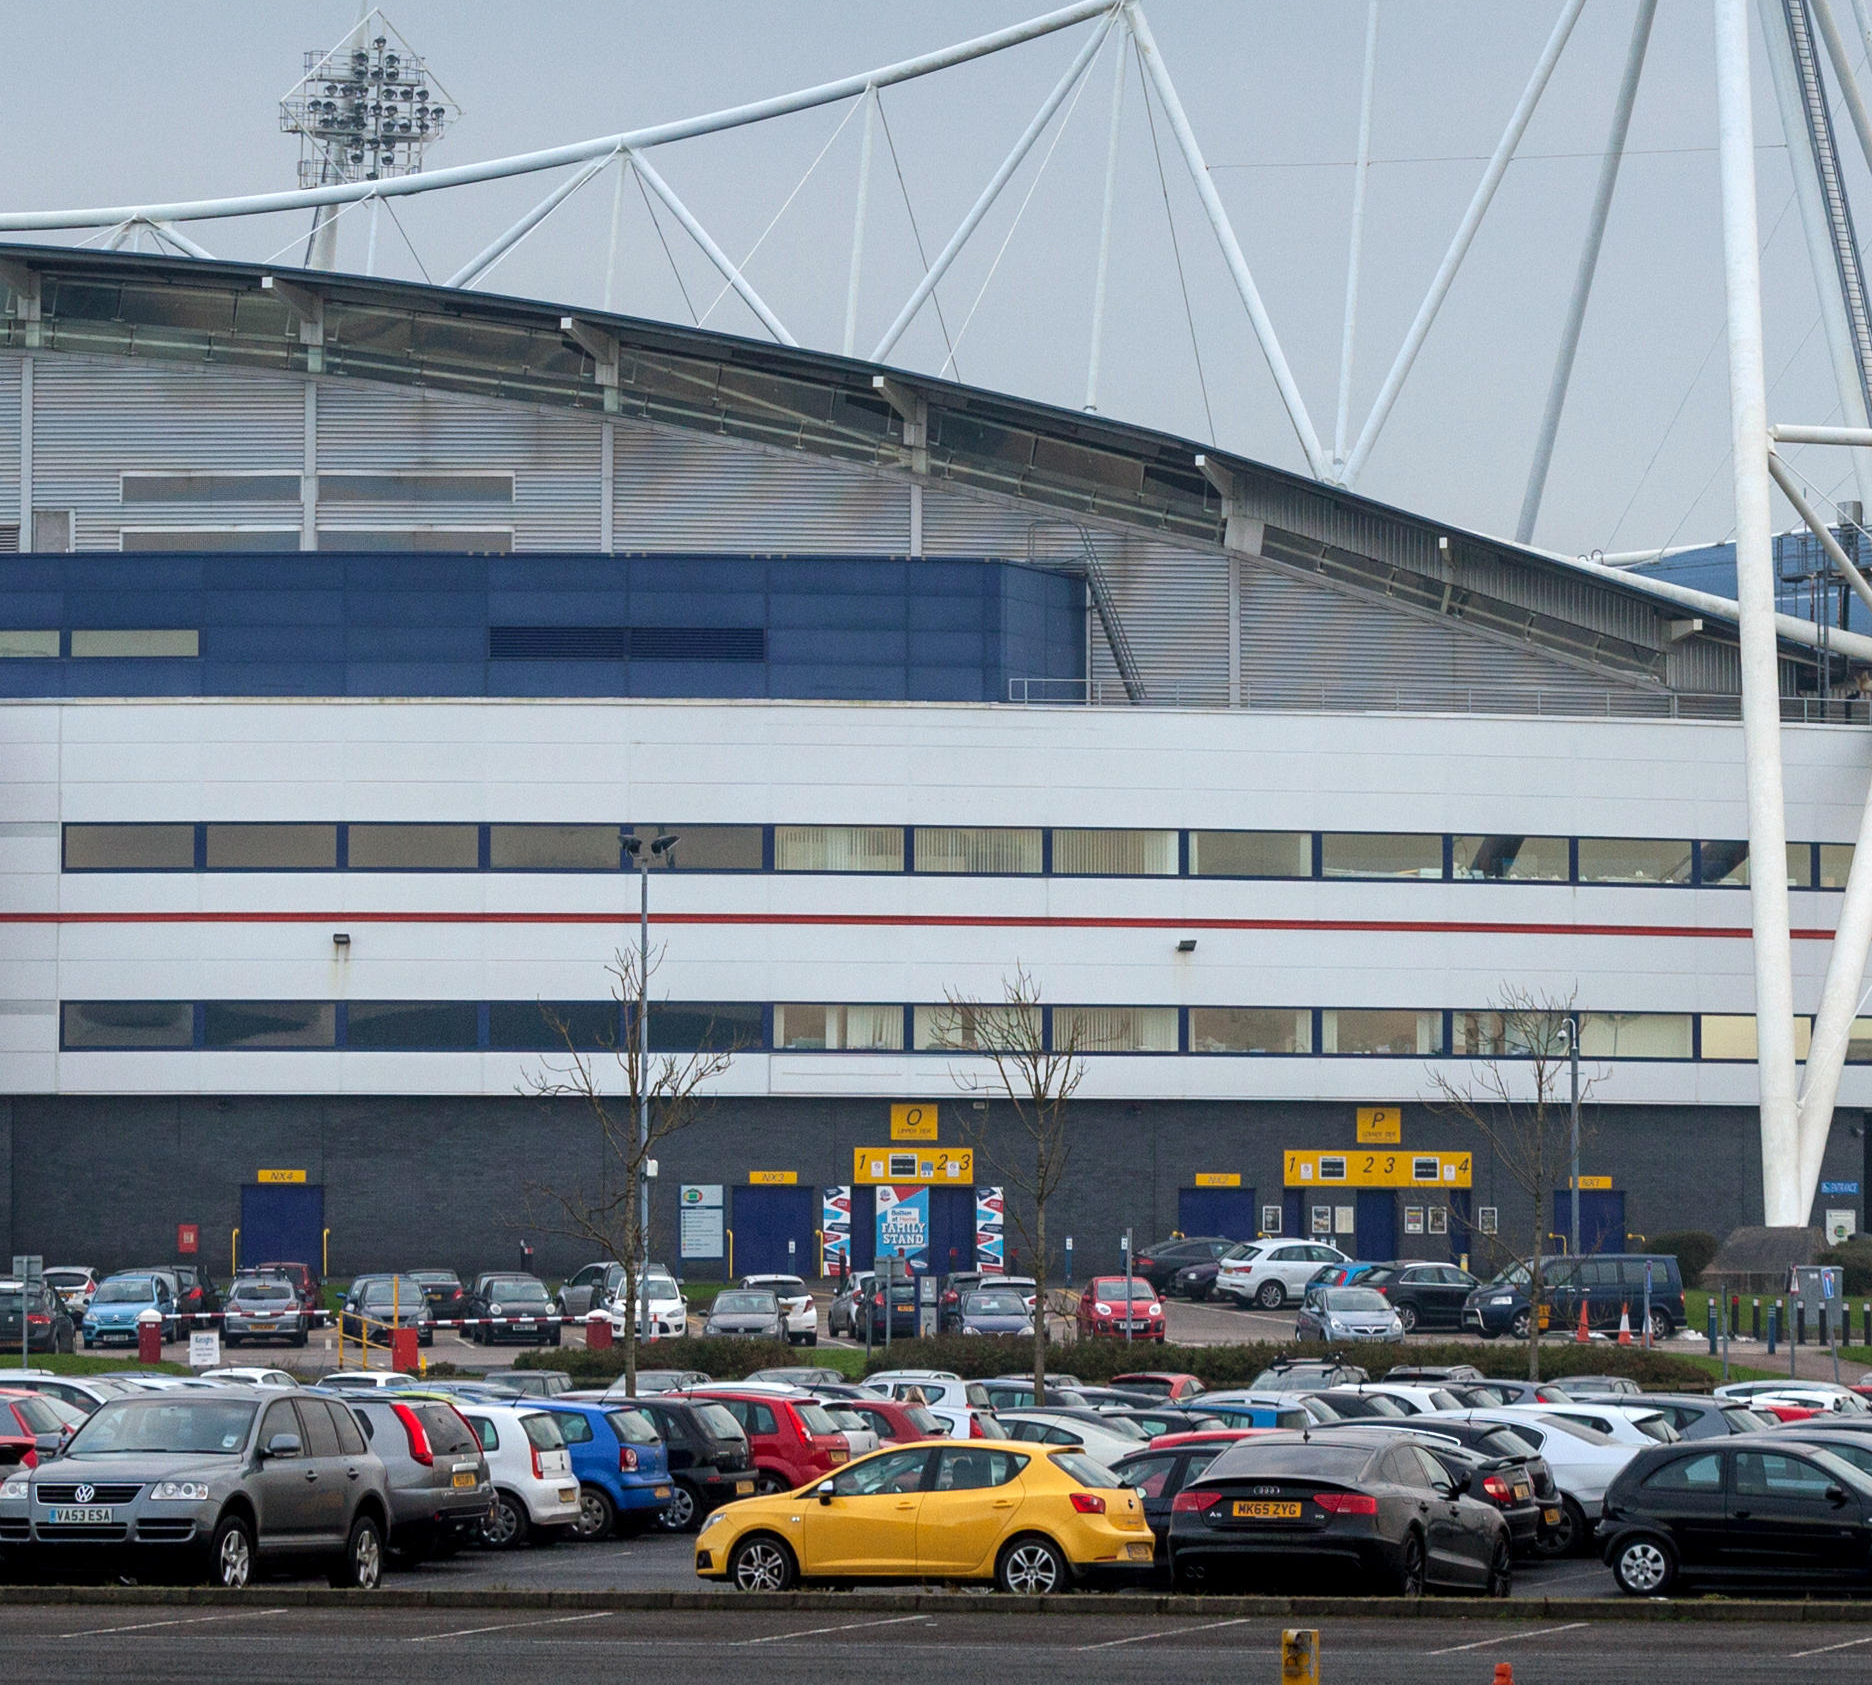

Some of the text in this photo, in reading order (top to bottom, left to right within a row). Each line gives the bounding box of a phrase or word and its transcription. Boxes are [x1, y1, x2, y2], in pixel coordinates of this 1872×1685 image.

[1371, 1112, 1385, 1129] P
[859, 1154, 866, 1170] 1
[937, 1153, 948, 1171] 2
[959, 1153, 971, 1171] 3
[1289, 1157, 1296, 1172] 1
[1363, 1157, 1375, 1173] 2
[1384, 1157, 1396, 1173] 3
[1458, 1158, 1470, 1173] 4
[270, 1172, 294, 1180] NX4
[881, 1223, 926, 1233] FAMILY
[883, 1234, 925, 1245] STAND
[56, 1509, 111, 1521] VA53 ESA
[1238, 1503, 1297, 1515] MK65 ZYG
